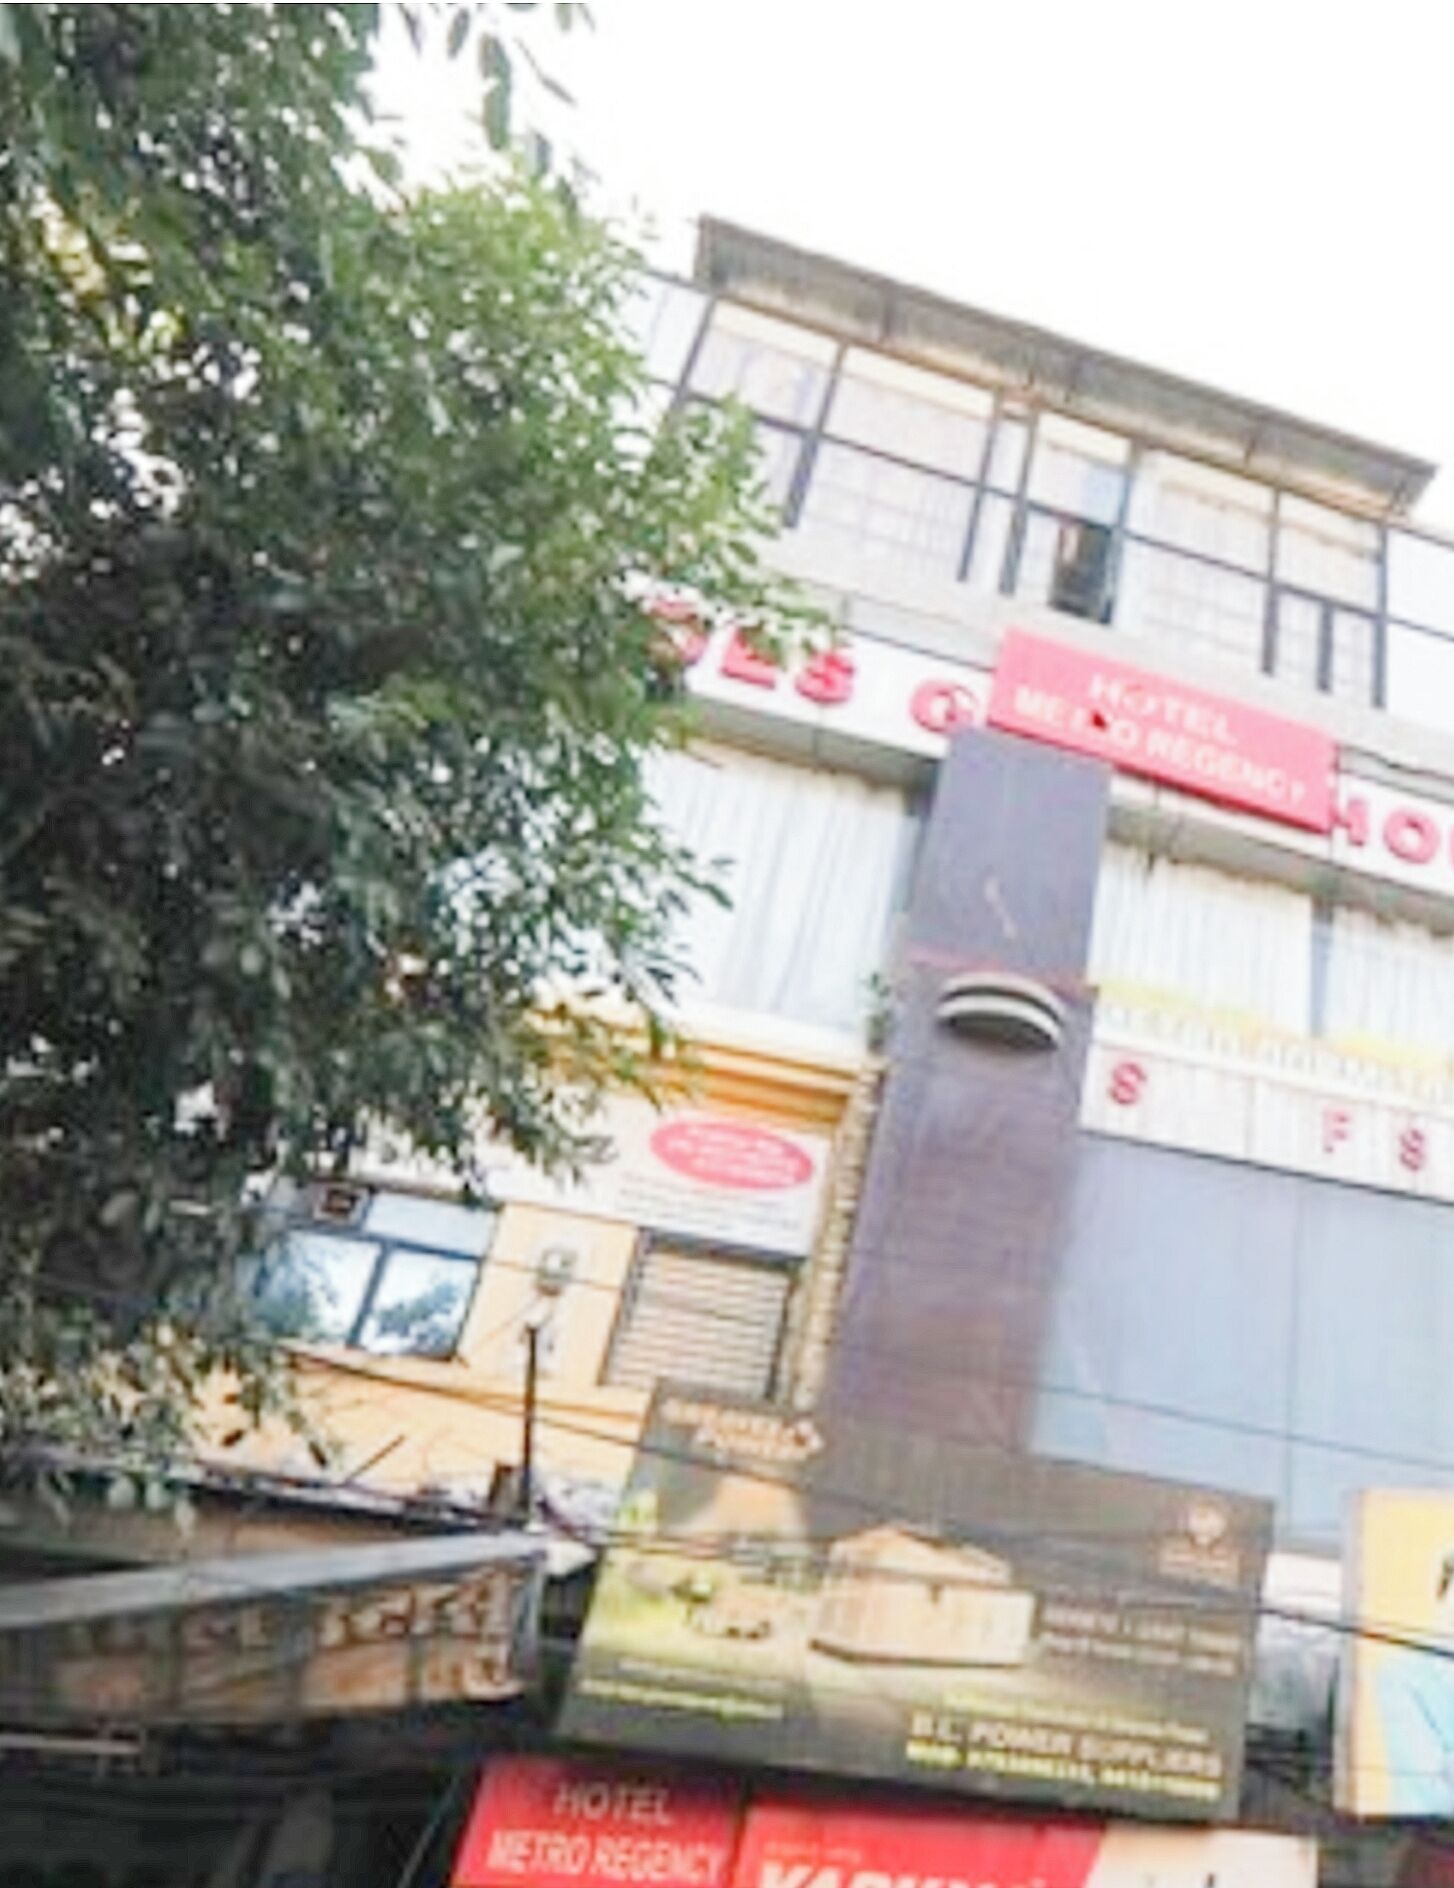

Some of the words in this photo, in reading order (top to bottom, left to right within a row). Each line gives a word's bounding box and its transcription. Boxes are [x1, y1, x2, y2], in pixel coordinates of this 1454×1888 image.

[1088, 674, 1236, 746] HOTEL
[1144, 726, 1306, 804] REGENCY
[554, 1781, 672, 1826] HOTEL
[486, 1829, 590, 1874] METRO
[588, 1835, 727, 1880] REGENCY
